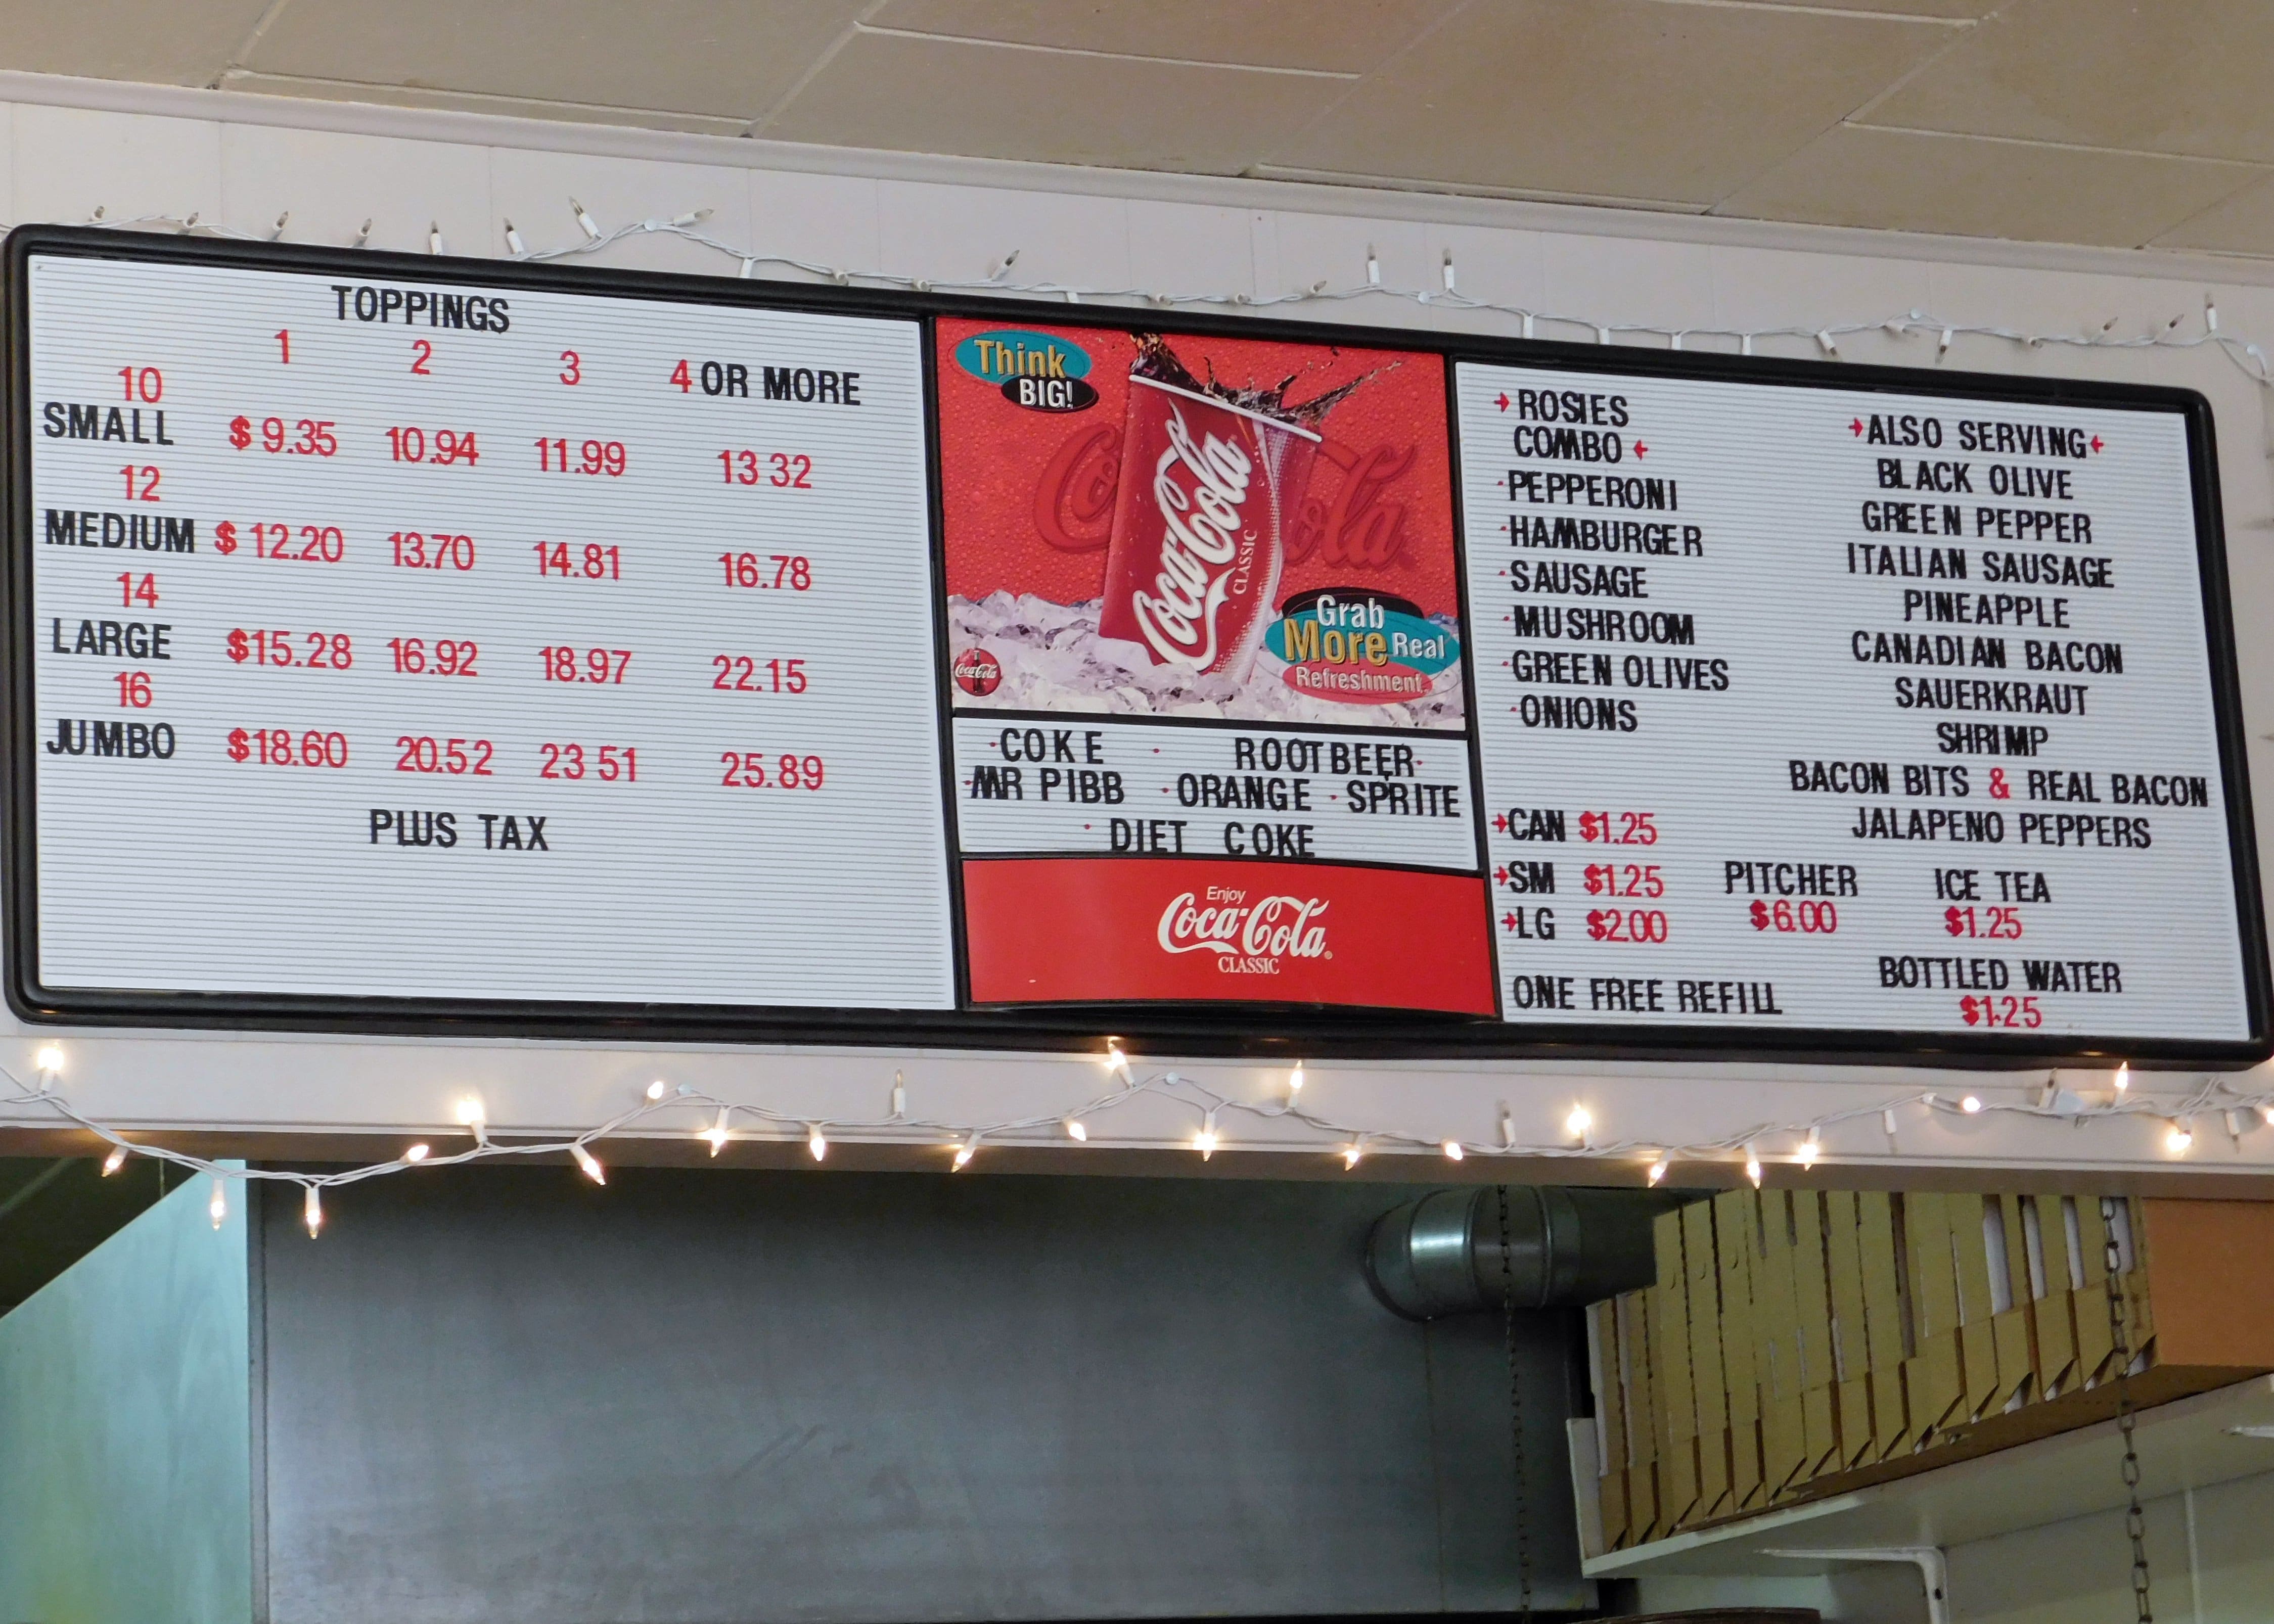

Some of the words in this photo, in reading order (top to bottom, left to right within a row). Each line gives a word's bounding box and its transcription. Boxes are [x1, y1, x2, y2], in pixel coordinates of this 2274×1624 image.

[331, 285, 510, 334] TOPPINGS
[277, 329, 290, 364] 1
[412, 339, 432, 375] 2
[561, 350, 581, 386] 3
[671, 360, 693, 393] 4
[701, 361, 748, 398] OR
[763, 366, 860, 406] MORE
[974, 339, 1065, 378] Think
[120, 366, 163, 403] 10
[1019, 378, 1073, 408] BIG!
[1518, 389, 1629, 428] ROSIES
[43, 402, 174, 445] SMALL
[388, 427, 480, 466] 10.94
[537, 438, 626, 477] 11.99
[1514, 425, 1622, 464] COMBO
[1867, 414, 1942, 449] ALSO
[1958, 420, 2086, 459] SERVING
[122, 465, 160, 502] 12
[1508, 470, 1677, 511] PEPPERONI
[1877, 458, 1973, 493] BLACK
[1989, 464, 2073, 500] OLIVE
[1510, 515, 1703, 557] HAMBURGER
[1861, 500, 1962, 536] GREEN
[1976, 507, 2092, 544] PEPPER
[46, 508, 195, 553] MEDIUM
[390, 532, 475, 571] 13.70
[535, 541, 620, 580] 14.81
[721, 552, 812, 591] 16.78
[1233, 530, 1257, 594] CLASSIC
[1847, 542, 1967, 579] ITALIAN
[1982, 551, 2115, 588] SAUSAGE
[118, 572, 159, 608] 14
[1510, 560, 1648, 598] SAUSAGE
[1317, 594, 1384, 629] Grab
[1514, 605, 1695, 645] MUSHROOM
[1904, 589, 2070, 629] PINEAPPLE
[54, 618, 171, 660] LARGE
[228, 628, 353, 670] $15.28
[389, 638, 478, 677] 16.92
[540, 646, 632, 684] 18.97
[714, 655, 807, 694] 22.15
[1284, 618, 1388, 666] More
[1392, 632, 1444, 659] Real
[1851, 630, 2007, 669] CANADIAN
[2024, 640, 2123, 674] BACON
[116, 671, 153, 708] 16
[1296, 666, 1424, 693] Refreshment
[1512, 649, 1612, 686] GREEN
[1623, 655, 1729, 691] OLIVES
[1520, 694, 1638, 732] ONIONS
[1894, 676, 2088, 716] SAUERKRAUT
[47, 718, 175, 759] JUMBO
[228, 727, 348, 768] $18.60
[397, 736, 493, 776] 20.52
[722, 752, 824, 791] 25.89
[1000, 727, 1104, 765] COKE
[1936, 722, 2049, 757] SHRIMP
[971, 765, 1023, 801] MR
[1040, 767, 1124, 805] PIBB
[1177, 773, 1311, 812] ORANGE
[1346, 779, 1461, 818] SPRITE
[1789, 760, 1890, 794] BACON
[1903, 764, 1970, 797] BITS
[1989, 767, 2011, 800] &
[2028, 769, 2102, 803] REAL
[2111, 773, 2208, 808] BACON
[370, 809, 458, 848] PLUS
[478, 814, 548, 851] TAX
[1110, 818, 1188, 854] DIET
[1223, 821, 1314, 856] COKE
[1507, 808, 1566, 843] CAN
[1579, 811, 1658, 846] $1.25
[1851, 807, 2004, 843] JALAPENO
[2019, 813, 2152, 849] PEPPERS
[1206, 886, 1246, 904] Enjoy
[1508, 860, 1555, 894] SM
[1584, 863, 1664, 898] $1.25
[1724, 861, 1858, 897] PITCHER
[1935, 868, 1981, 901] ICE
[1994, 871, 2051, 903] TEA
[1517, 906, 1555, 941] LG
[1945, 906, 2023, 940] $1.25
[1218, 956, 1280, 975] CLASSIC
[1879, 955, 2009, 990] BOTTLED
[2022, 959, 2122, 993] WATER
[1513, 975, 1575, 1010] ONE
[1590, 978, 1664, 1013] FREE
[1677, 980, 1783, 1015] REFILL
[1960, 995, 2042, 1029] $1.25
